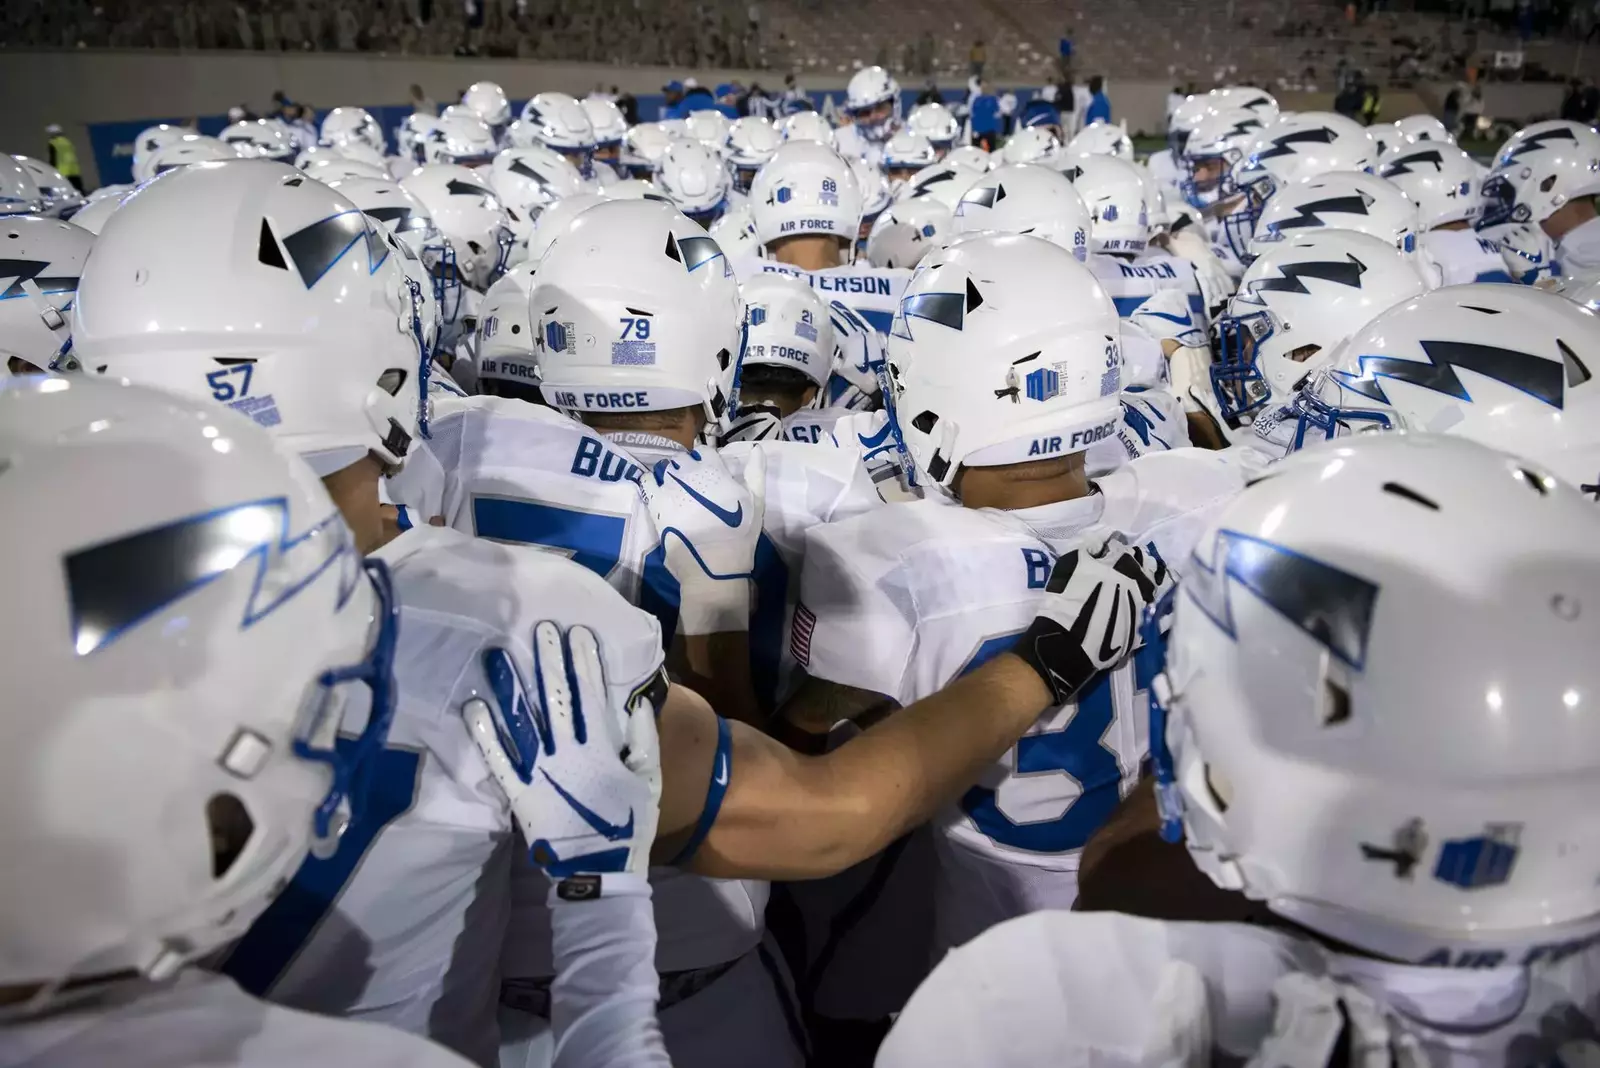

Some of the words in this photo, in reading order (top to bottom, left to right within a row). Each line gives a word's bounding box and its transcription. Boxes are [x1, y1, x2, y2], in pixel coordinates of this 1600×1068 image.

[821, 179, 837, 193] 88
[780, 222, 796, 233] AIR
[800, 219, 835, 231] FORCE
[1102, 240, 1120, 250] AIR
[762, 265, 891, 296] ERSON
[801, 309, 814, 325] 21
[619, 318, 650, 341] 79
[770, 345, 810, 366] FORCE
[1104, 345, 1120, 370] 33
[481, 359, 497, 374] AIR
[500, 361, 542, 381] FORC
[205, 362, 253, 402] 57
[553, 390, 578, 408] AIR
[583, 391, 649, 410] FORCE
[1027, 436, 1063, 457] AIR
[1070, 418, 1118, 449] FORCE
